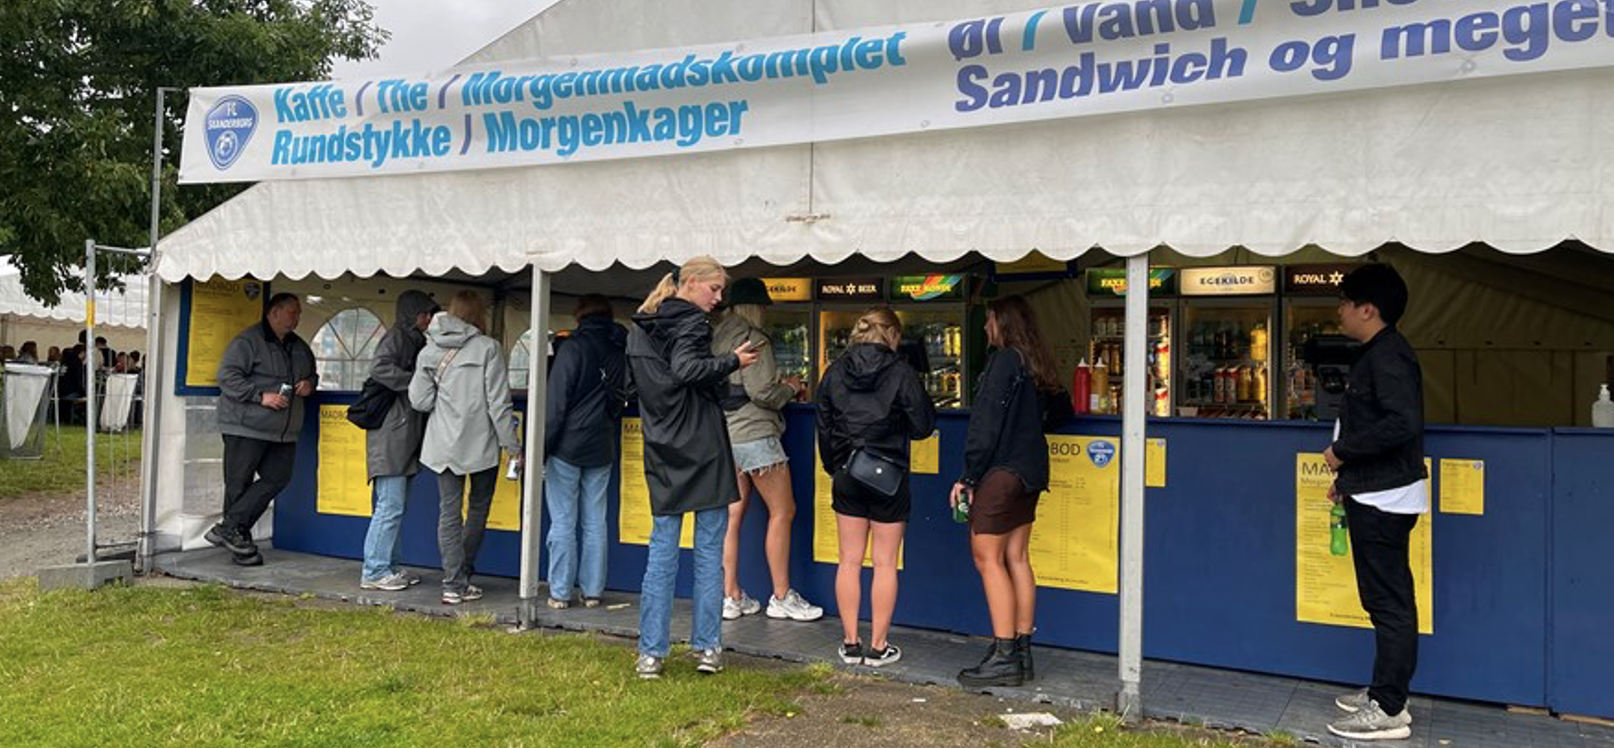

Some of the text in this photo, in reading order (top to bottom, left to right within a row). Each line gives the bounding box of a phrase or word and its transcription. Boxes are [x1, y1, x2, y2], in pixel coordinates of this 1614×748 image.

[1063, 0, 1216, 44] Vand
[274, 84, 347, 123] Kaffe
[377, 79, 428, 114] The
[462, 31, 907, 110] Morgenmadskomplet
[955, 38, 1248, 112] Sandwich
[1269, 33, 1356, 81] og
[271, 118, 450, 168] Rundstykke
[485, 100, 749, 156] Morgenkager
[1200, 276, 1254, 285] EGEKILDE
[1294, 274, 1327, 284] ROYAL
[1051, 443, 1081, 456] BOD
